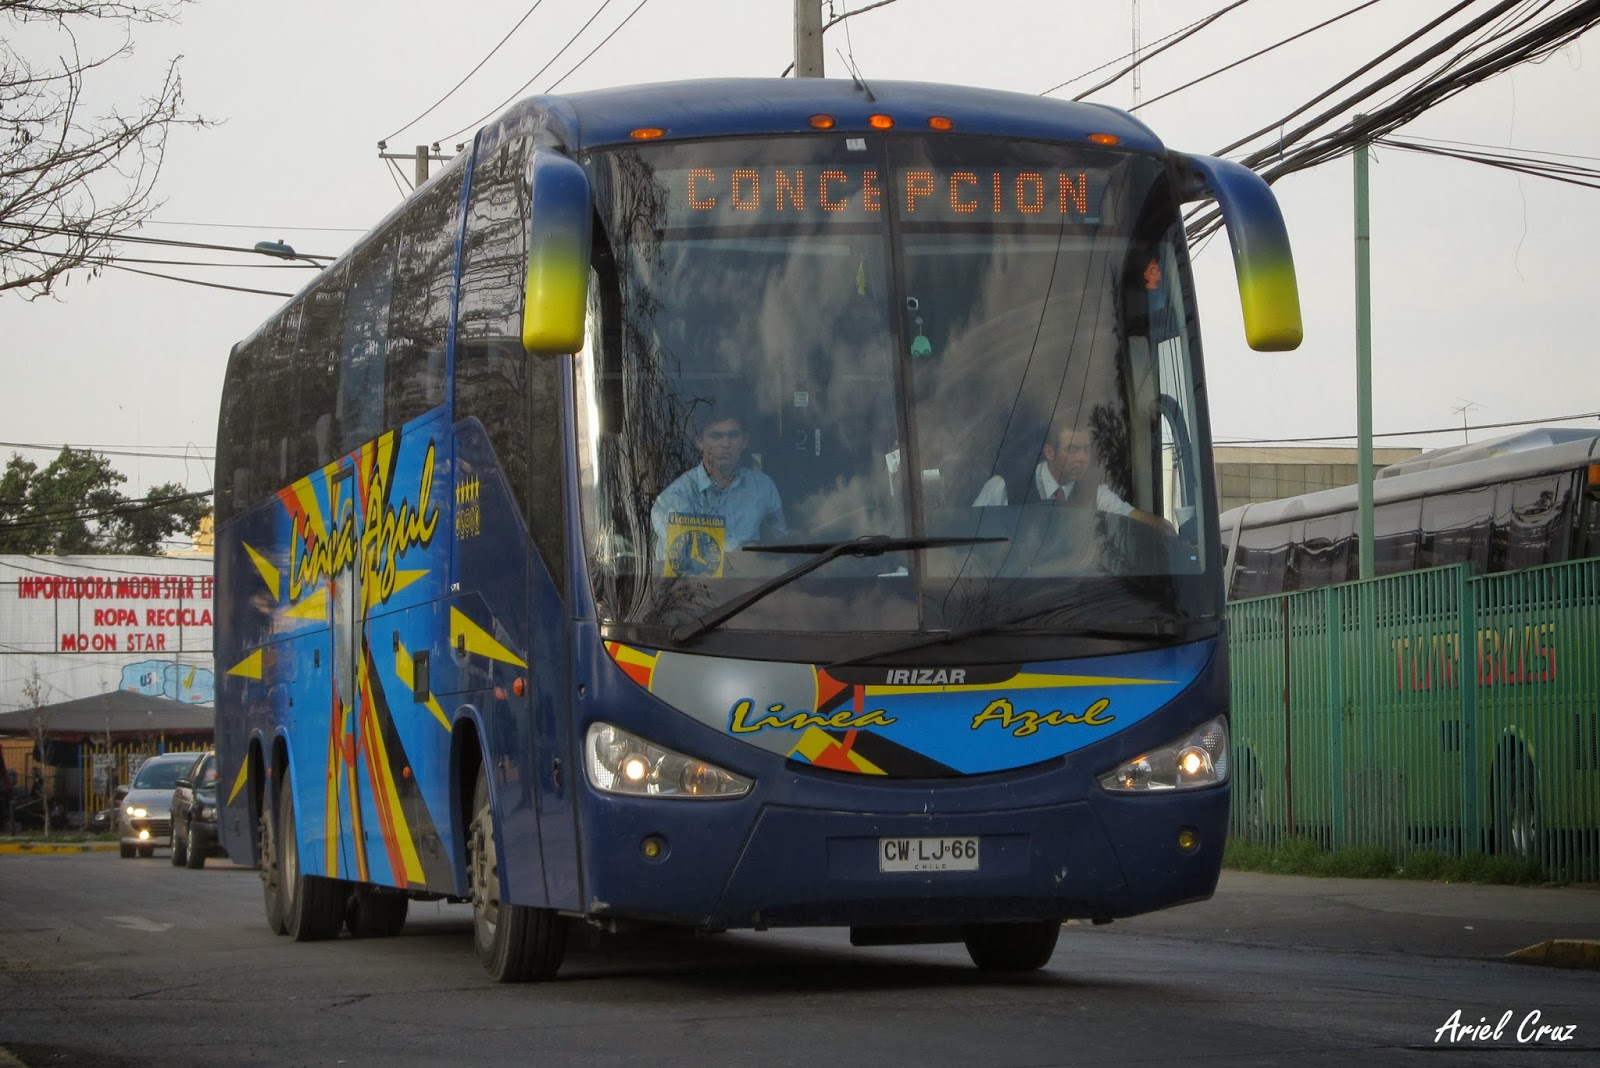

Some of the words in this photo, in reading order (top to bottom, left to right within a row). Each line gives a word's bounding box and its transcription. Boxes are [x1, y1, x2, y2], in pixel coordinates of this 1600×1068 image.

[687, 168, 1087, 213] CONCEPCION
[360, 439, 439, 605] Azul
[18, 576, 114, 600] IMPORTADORA
[117, 576, 161, 600] MOON
[164, 576, 194, 600] STAR
[94, 608, 139, 627] ROPA
[61, 633, 117, 651] MOON
[127, 633, 166, 651] STAR
[886, 669, 967, 685] IRIZAR
[728, 698, 898, 734] Linea
[970, 698, 1116, 738] Azul
